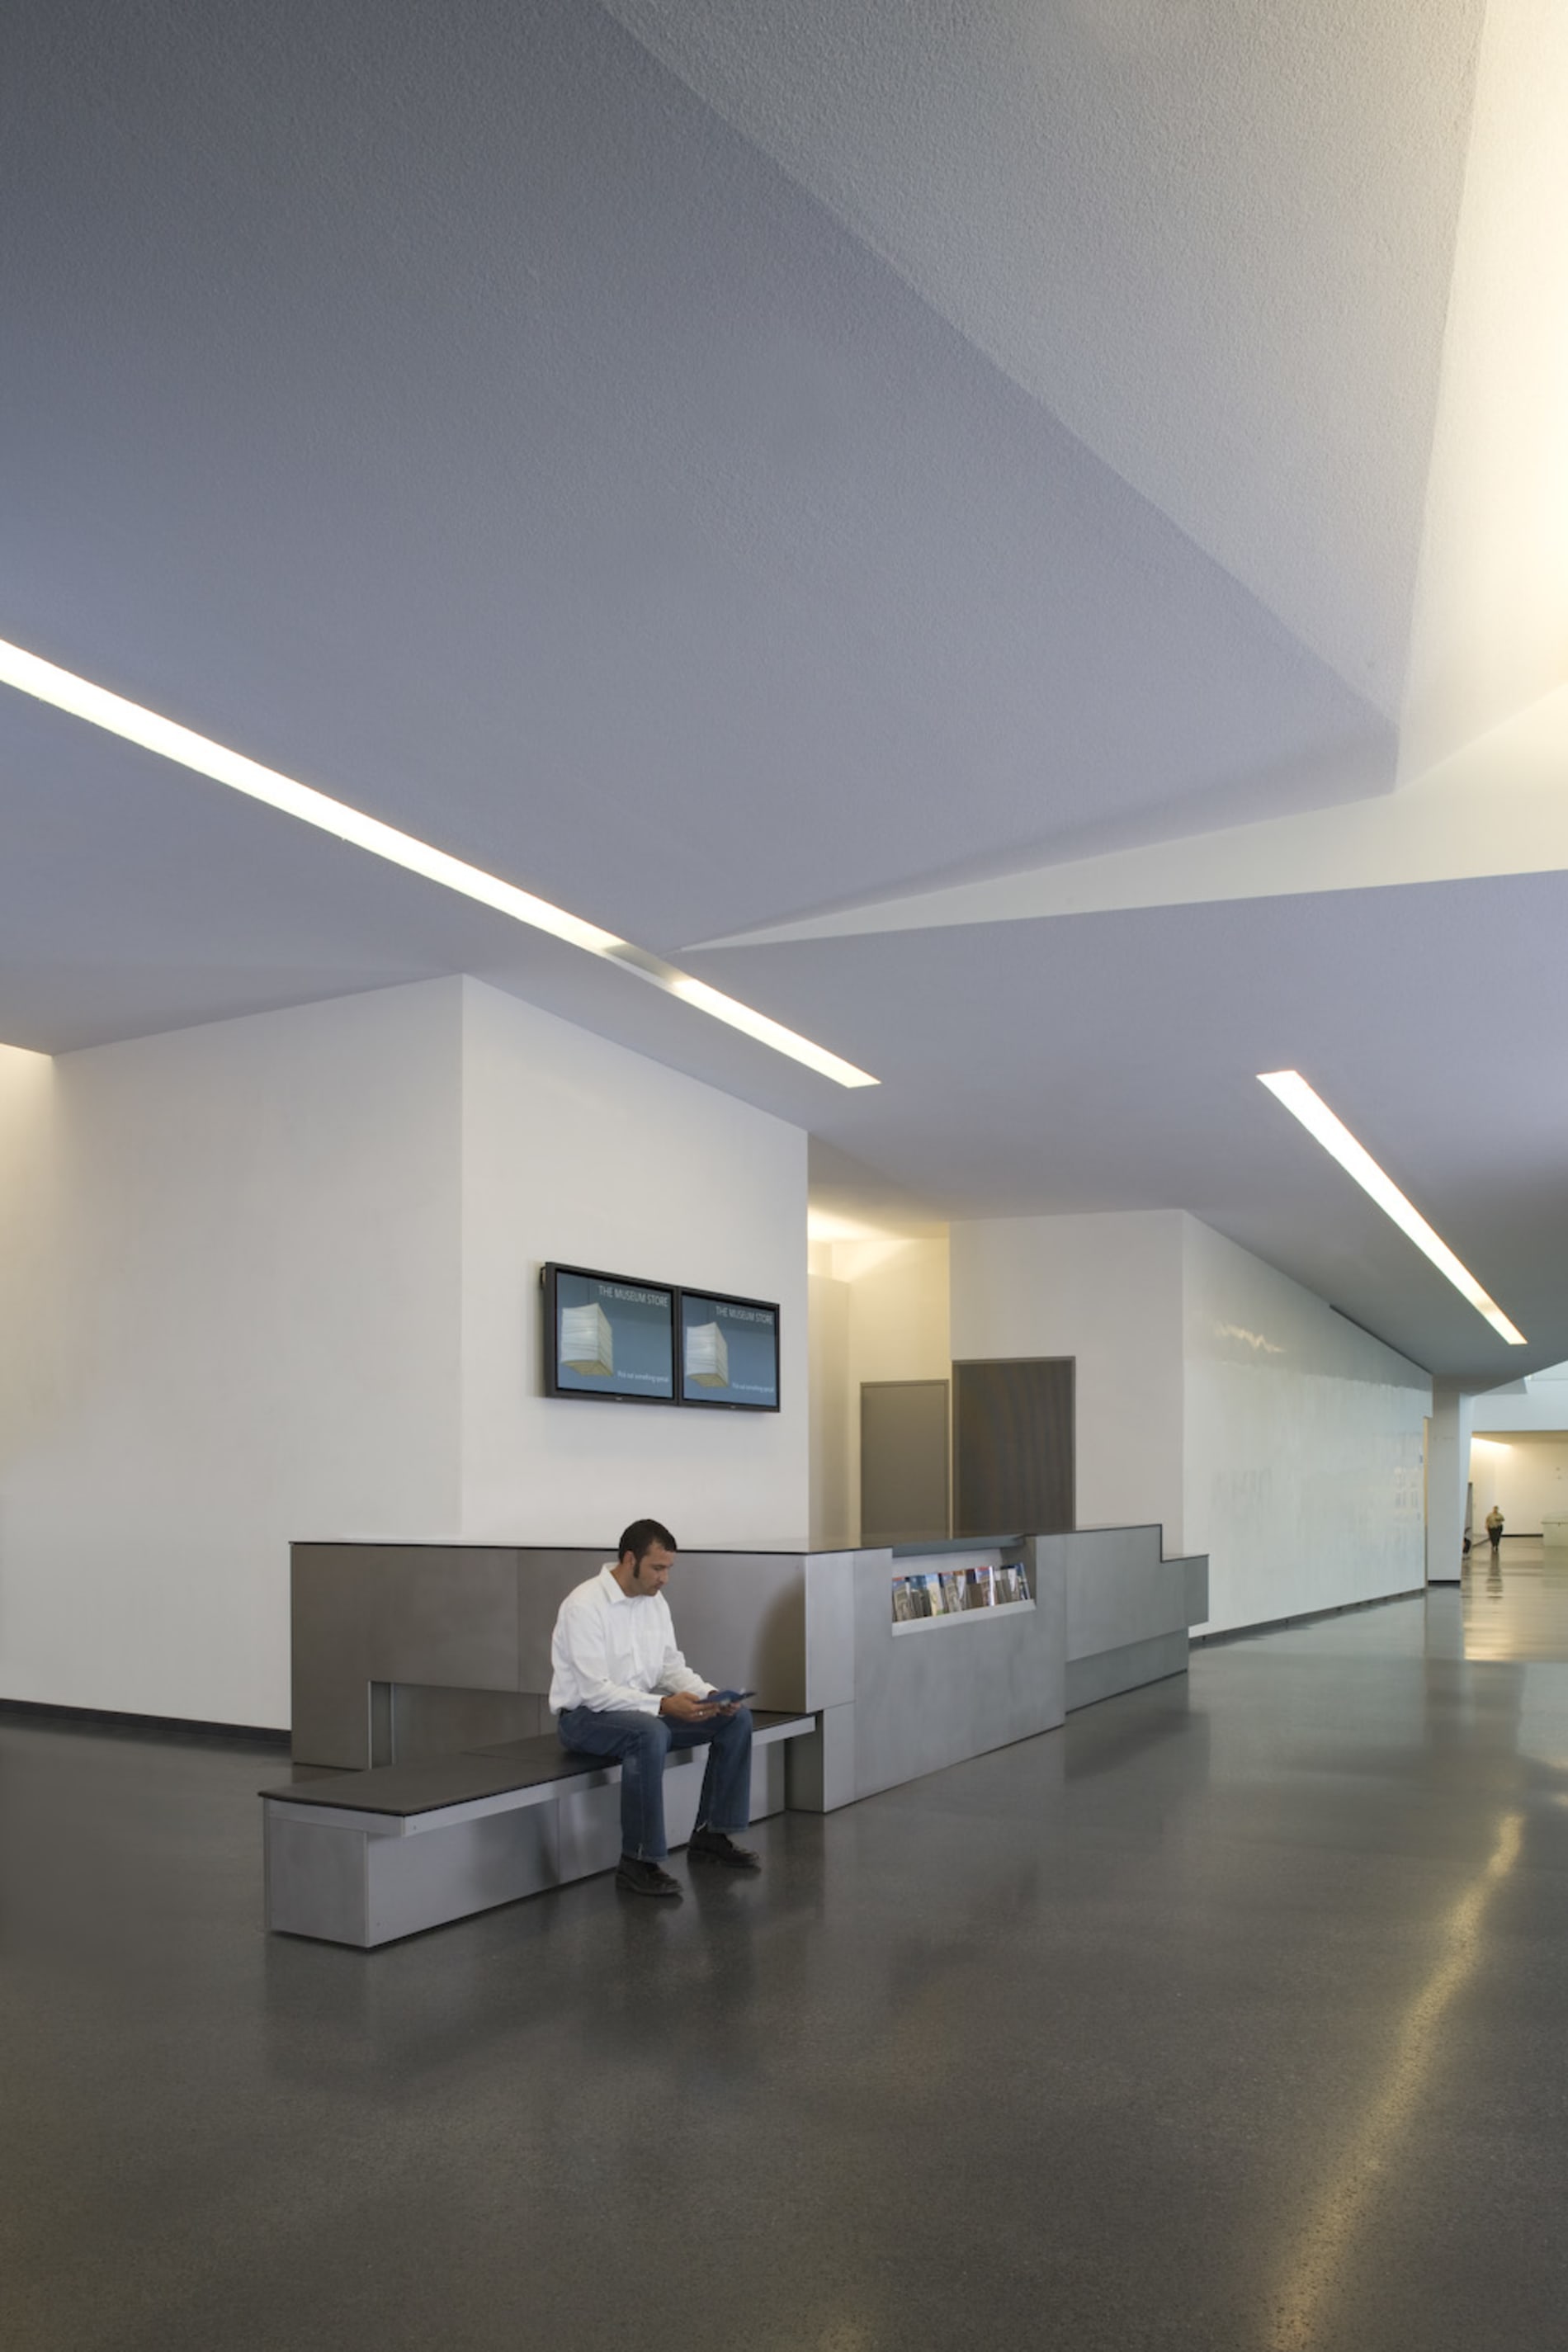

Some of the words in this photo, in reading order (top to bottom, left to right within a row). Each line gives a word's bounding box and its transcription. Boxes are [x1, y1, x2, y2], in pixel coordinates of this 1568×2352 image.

[598, 1285, 613, 1298] THE
[614, 1288, 646, 1303] MUSEUM
[647, 1294, 668, 1307] STORE
